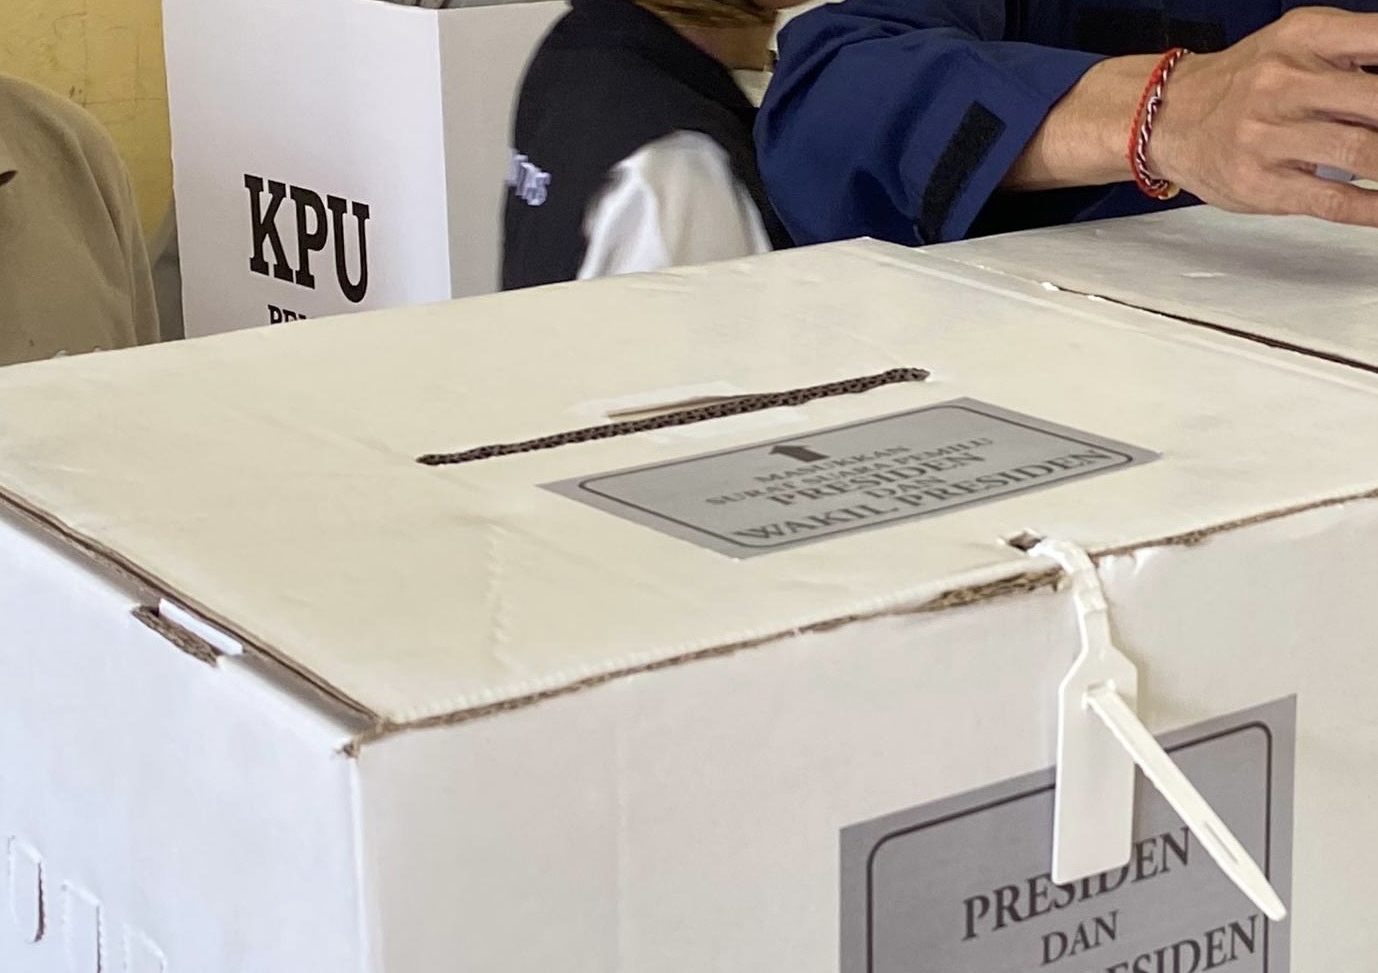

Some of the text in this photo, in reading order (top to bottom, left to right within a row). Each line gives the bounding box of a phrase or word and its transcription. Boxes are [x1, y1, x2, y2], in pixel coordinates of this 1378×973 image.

[244, 174, 370, 303] KPU
[705, 437, 993, 505] SURAT SUARA PEMILU
[754, 446, 910, 483] MASUKKAN
[767, 452, 985, 505] PRESIDEN
[863, 476, 946, 498] DAN
[734, 448, 1113, 539] WAKIL PRESIDEN
[1040, 910, 1118, 966] DAN
